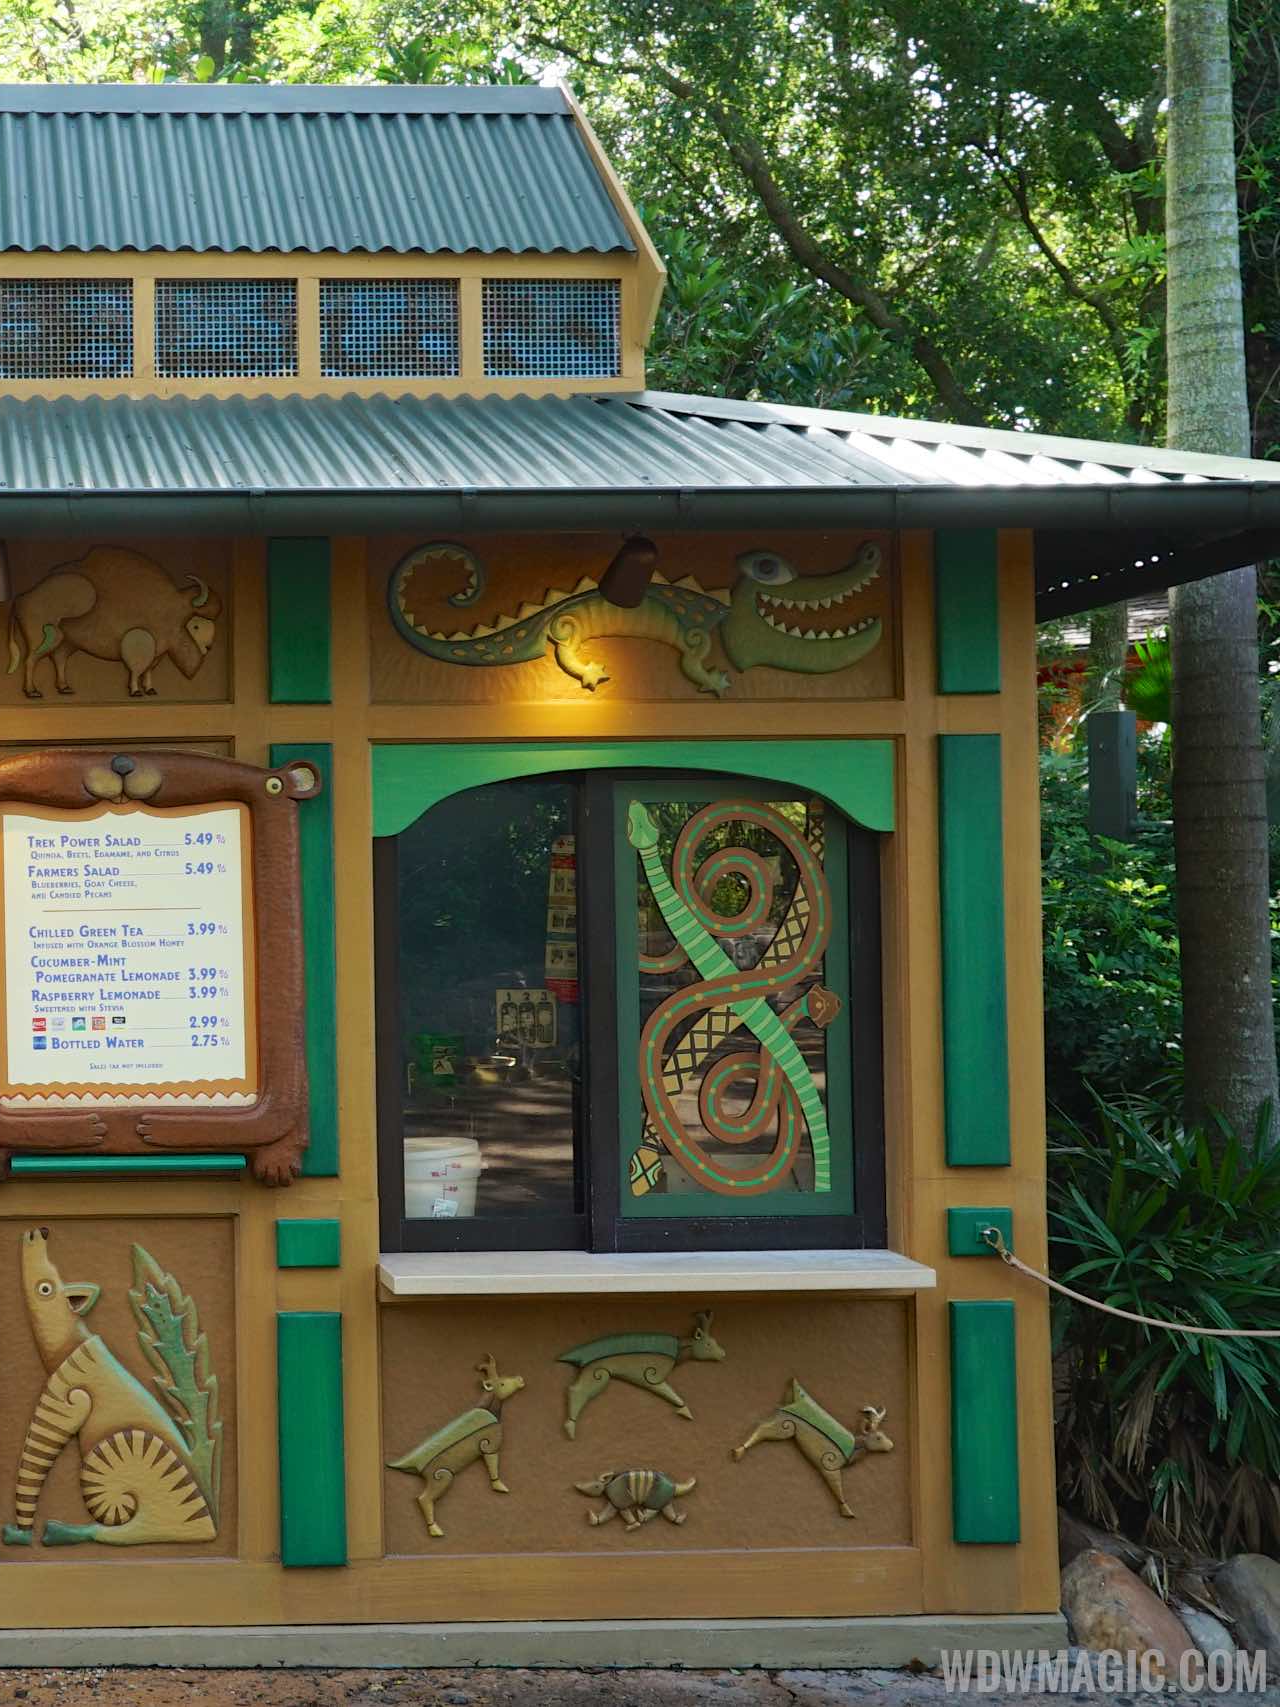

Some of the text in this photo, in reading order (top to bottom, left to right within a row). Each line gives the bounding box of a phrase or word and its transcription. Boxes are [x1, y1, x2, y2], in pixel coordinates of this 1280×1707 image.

[27, 836, 55, 848] TREK
[61, 835, 100, 847] POWER
[105, 834, 141, 847] SALAD
[184, 833, 213, 845] 5.49
[154, 849, 180, 857] CITRUS
[28, 865, 79, 877] FARMERS
[84, 864, 120, 877] SALAD
[184, 862, 214, 875] 5.49
[84, 879, 105, 888] GOAT
[31, 890, 112, 900] AND CANDIED PECANS
[29, 926, 74, 939] CHILLED
[79, 925, 117, 937] GREEN
[121, 924, 144, 937] TEA
[187, 923, 216, 936] 3.99
[33, 939, 185, 950] INFUSED WITH ORANGE BLOSSOM HONEY
[30, 954, 127, 968] CUCUMBER-MINT
[35, 970, 116, 984] POMEGRANATE
[121, 969, 181, 982] LEMONADE
[188, 968, 217, 981] 3.99
[31, 989, 95, 1002] RASPBERRY
[100, 988, 161, 1000] LEMONADE
[188, 986, 217, 999] 3.99
[34, 1003, 125, 1013] SWEETENED WITH STEVIA
[189, 1015, 217, 1029] 2.99
[51, 1037, 101, 1049] BOTTLED
[106, 1036, 145, 1048] WATER
[191, 1034, 218, 1047] 2.75
